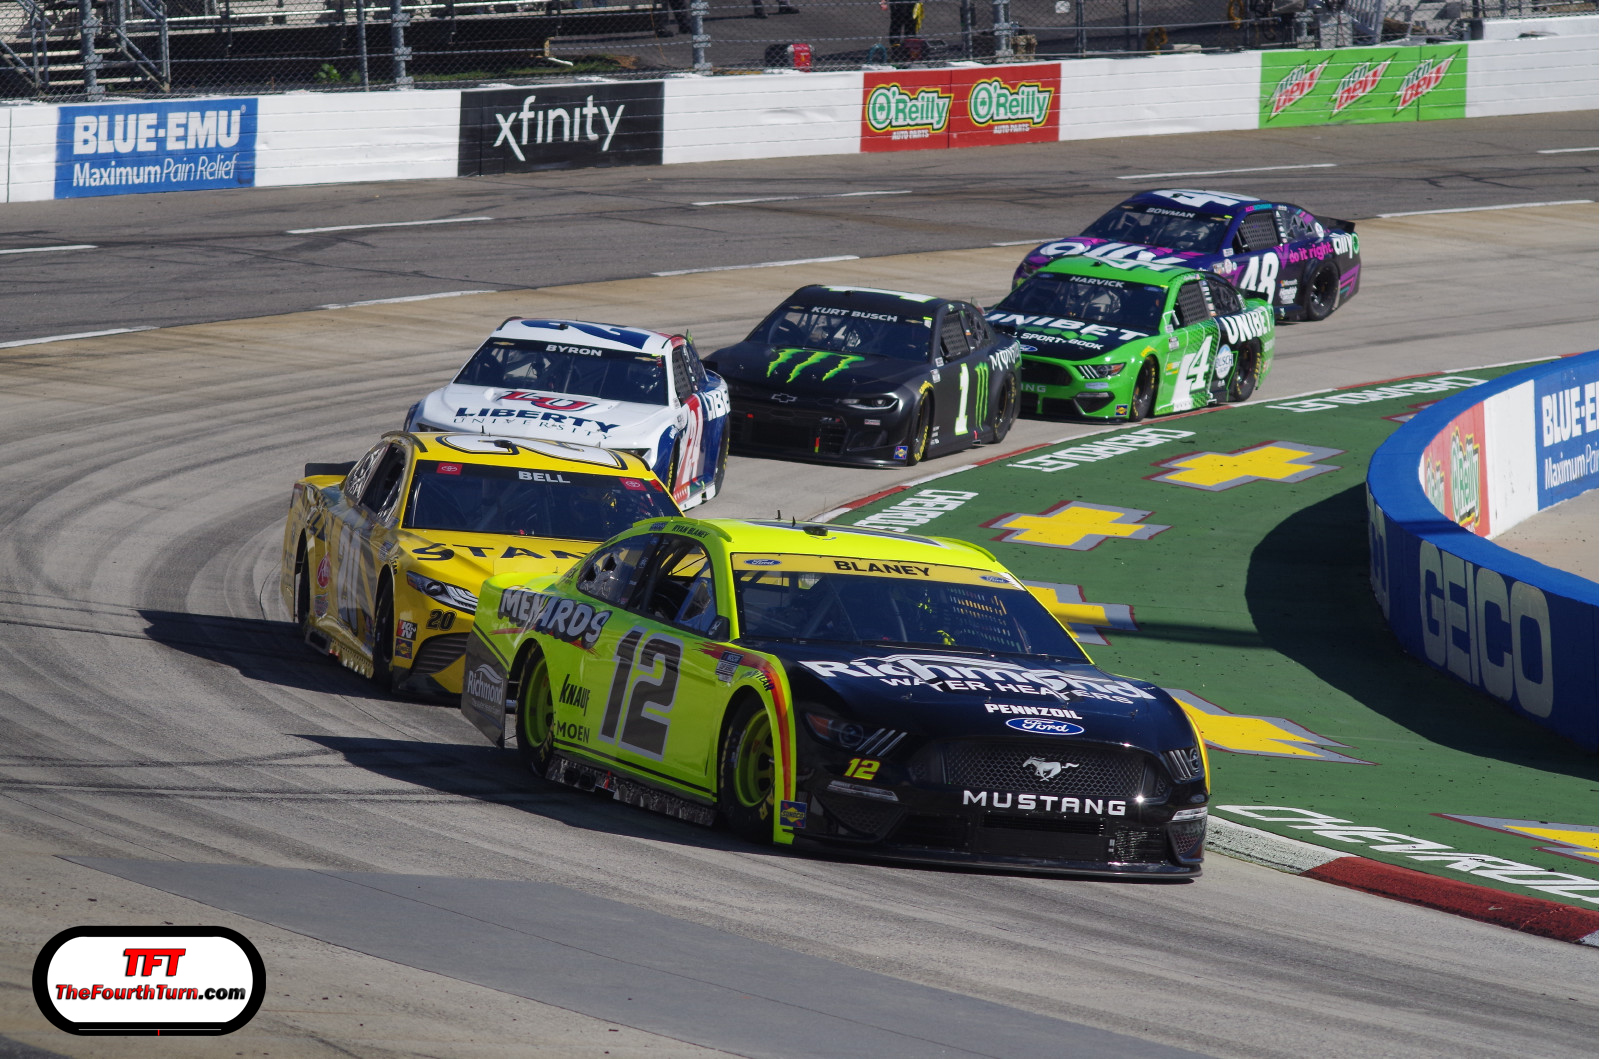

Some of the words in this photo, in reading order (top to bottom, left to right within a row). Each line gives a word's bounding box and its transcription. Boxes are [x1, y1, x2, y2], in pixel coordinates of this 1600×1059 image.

[869, 87, 949, 128] O'Reilly
[970, 80, 1051, 123] O'Reilly
[493, 95, 625, 161] xfinity
[891, 131, 908, 140] AUTO
[909, 129, 929, 139] PARTS
[993, 125, 1009, 134] AUTO
[1010, 123, 1030, 133] PARTS
[73, 161, 160, 187] Maximum
[162, 157, 195, 181] Pain
[197, 152, 240, 180] Relief
[1146, 207, 1196, 218] BOWMAN
[1289, 248, 1300, 263] do
[1300, 247, 1308, 261] it
[1069, 275, 1126, 289] HARVICK
[1240, 252, 1280, 304] 48
[811, 306, 849, 316] KURT
[851, 310, 898, 323] BUSCH
[1220, 305, 1271, 345] UNIBET
[546, 344, 602, 357] BYRON
[955, 363, 969, 436] 1
[453, 418, 613, 440] UNIVERSITY
[455, 407, 621, 433] LIBERTY
[1006, 428, 1196, 473] CHEVROLET
[518, 470, 571, 484] BELL
[1545, 451, 1585, 490] Maximum
[672, 524, 689, 532] RYAN
[687, 527, 709, 539] BLANEY
[832, 560, 930, 577] BLANEY
[426, 609, 457, 631] 20
[500, 588, 611, 645] MENARDS
[1419, 539, 1554, 719] GEICO
[467, 670, 504, 706] Richmond
[797, 656, 1157, 699] Richmond
[598, 625, 685, 762] 12
[879, 678, 990, 692] WATER
[997, 682, 1135, 705] HEATERS
[984, 703, 1083, 719] PENNZOIL
[556, 720, 591, 744] MOEN
[1021, 718, 1070, 733] Ford
[844, 757, 881, 780] 12
[962, 790, 1127, 816] MUSTANG
